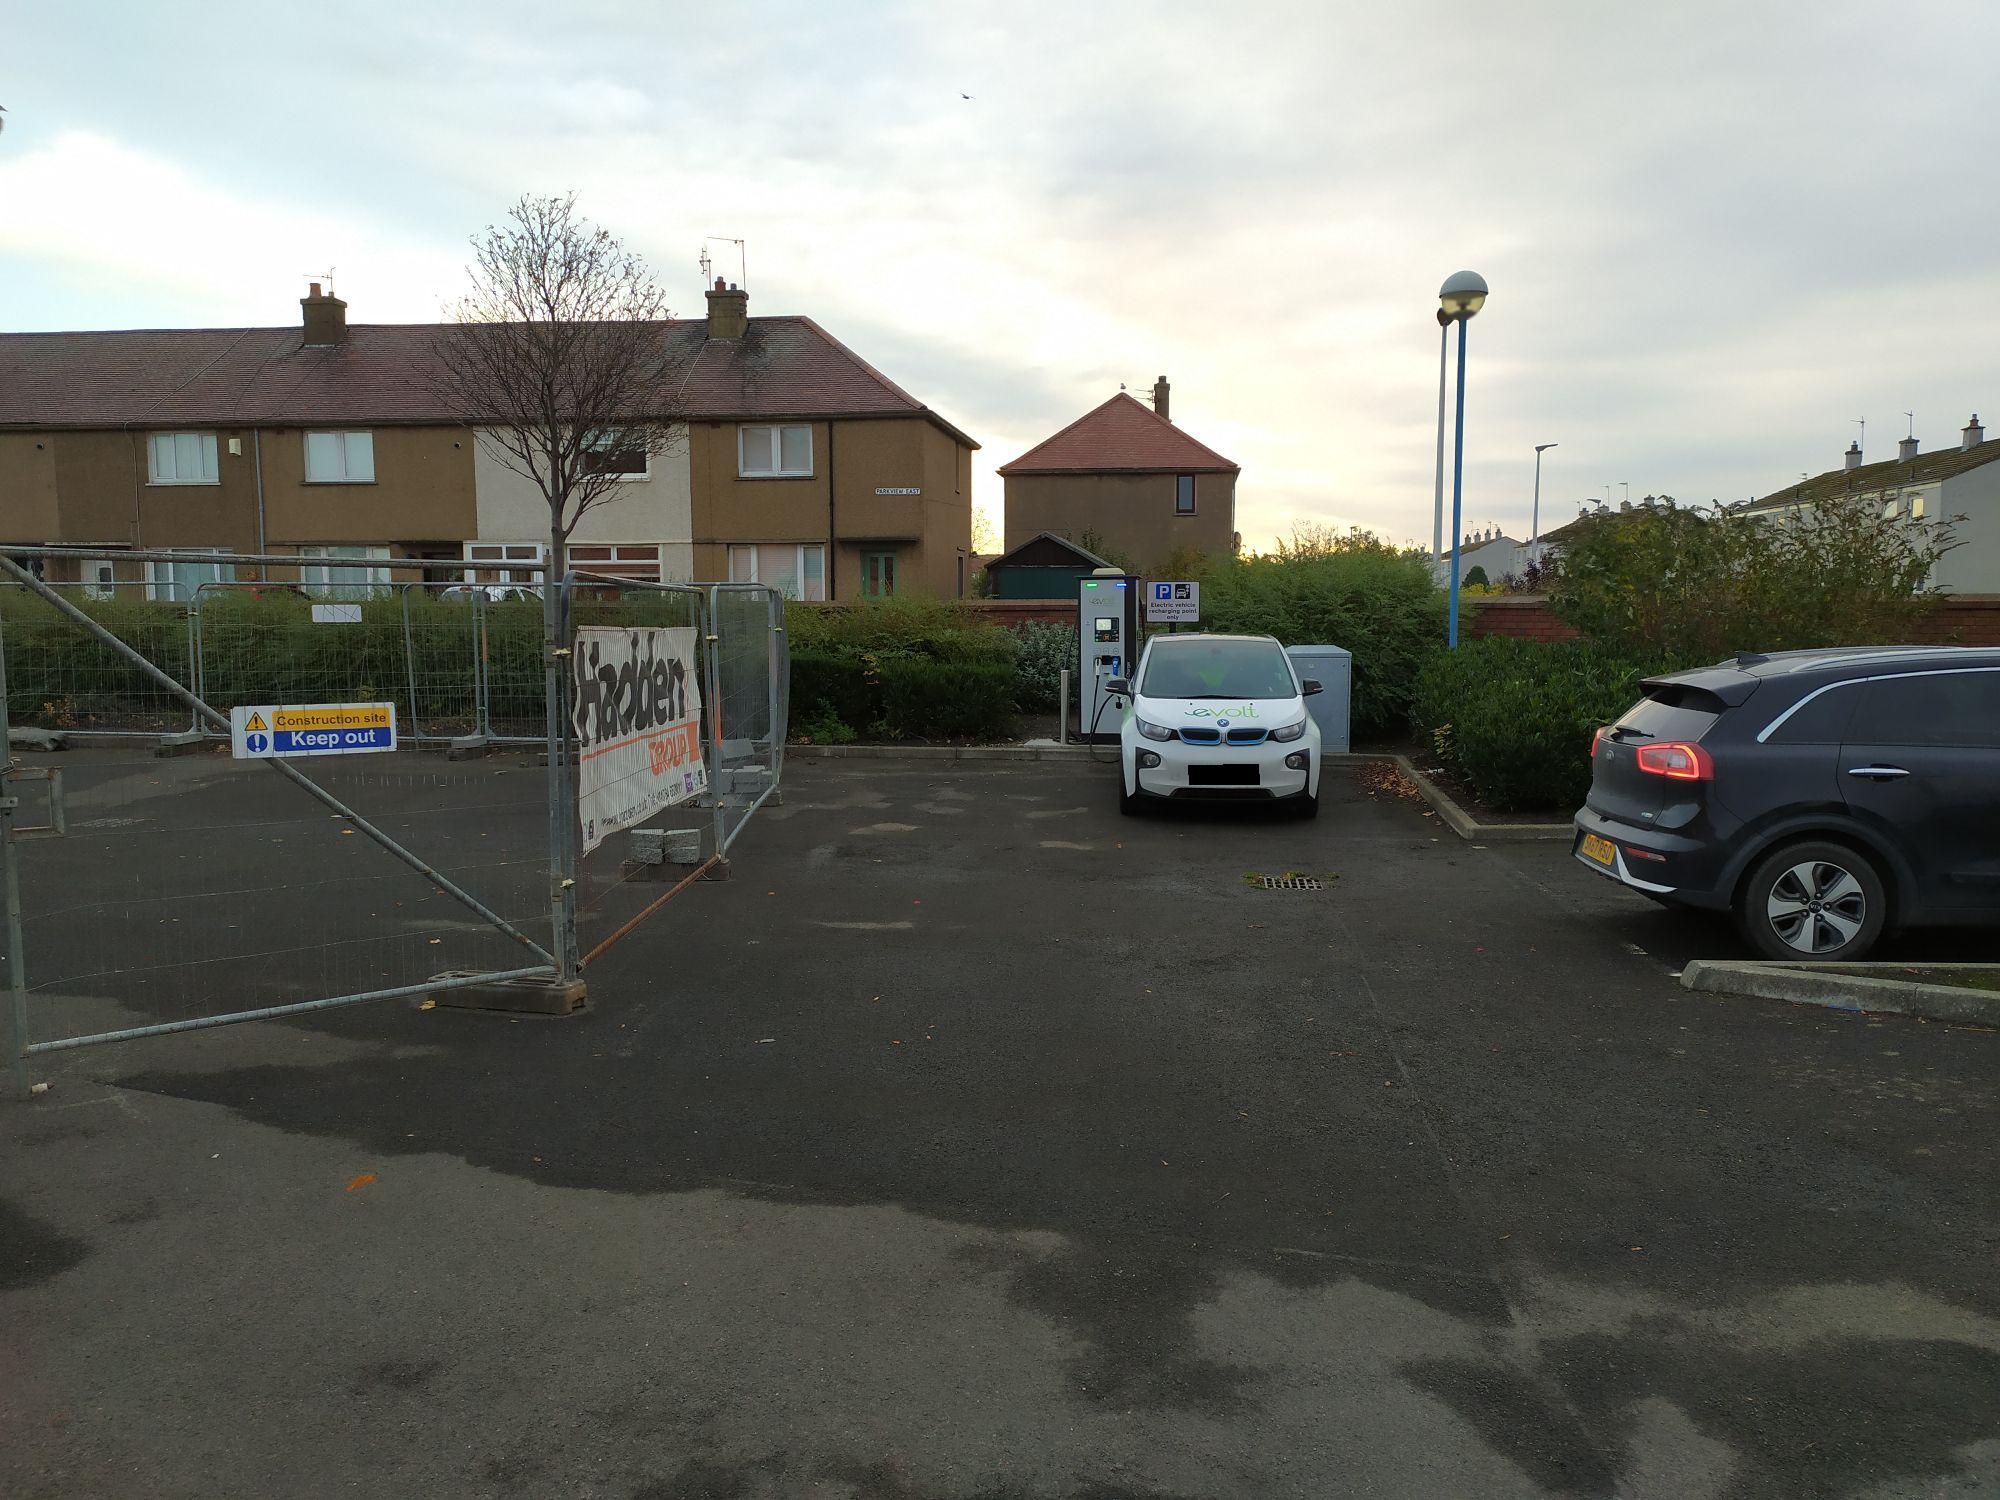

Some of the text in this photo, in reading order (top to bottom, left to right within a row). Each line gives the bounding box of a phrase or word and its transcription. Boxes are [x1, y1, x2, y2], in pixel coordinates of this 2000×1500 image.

[1160, 585, 1170, 599] P
[576, 631, 685, 748] Hadden
[276, 712, 386, 726] Construction site
[1184, 706, 1259, 718] evolt
[291, 729, 376, 748] Keep out
